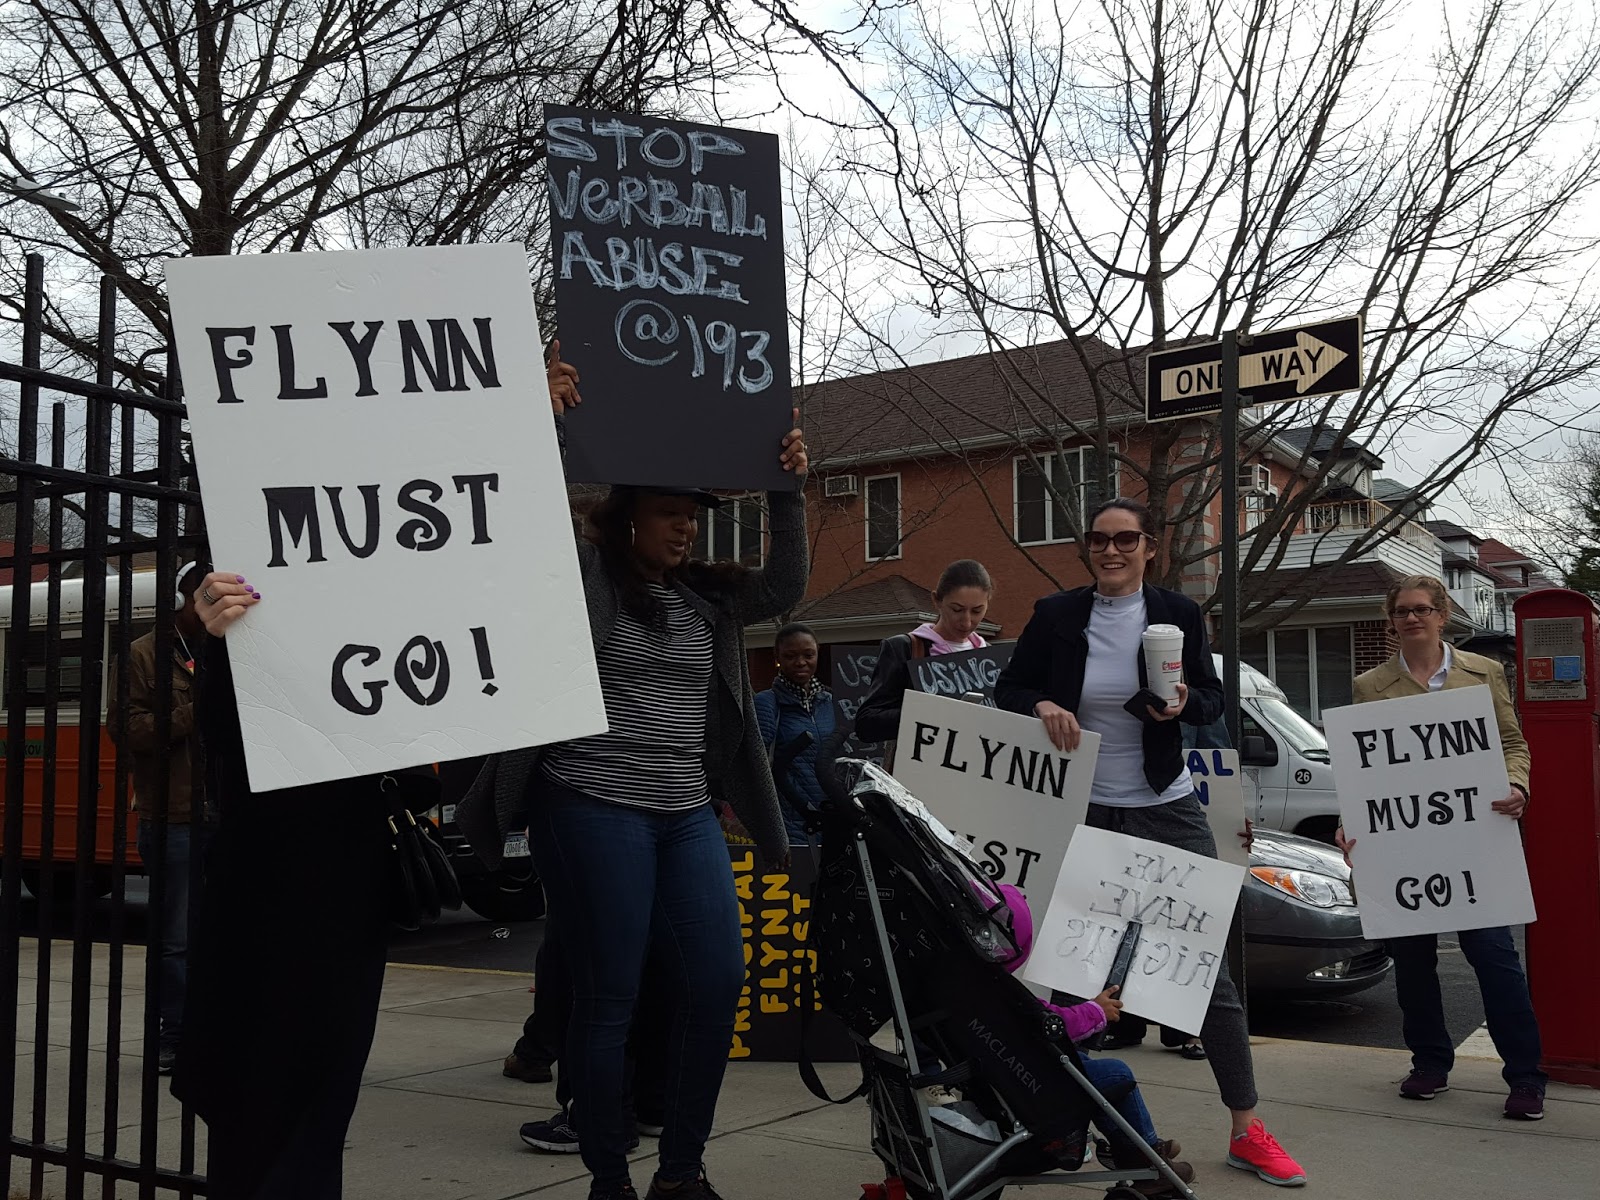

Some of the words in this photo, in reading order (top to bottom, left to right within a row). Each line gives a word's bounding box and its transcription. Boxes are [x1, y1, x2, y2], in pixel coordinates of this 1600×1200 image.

[546, 116, 747, 176] STOP
[559, 230, 750, 304] ABUSE
[205, 317, 502, 404] FLYNN
[614, 299, 775, 394] @193
[1176, 364, 1223, 394] ON
[1261, 345, 1326, 381] WAY
[1184, 402, 1223, 413] TRANSPORTAT
[261, 472, 499, 568] MUST
[911, 721, 1072, 800] FLYNN
[1352, 717, 1491, 768] FLYNN
[1296, 770, 1311, 783] 26
[1366, 787, 1479, 834] MUST
[949, 830, 1042, 889] ST
[1396, 871, 1477, 912] GO!
[759, 873, 791, 1013] FLYNN
[968, 1018, 1042, 1095] MACLAREN
